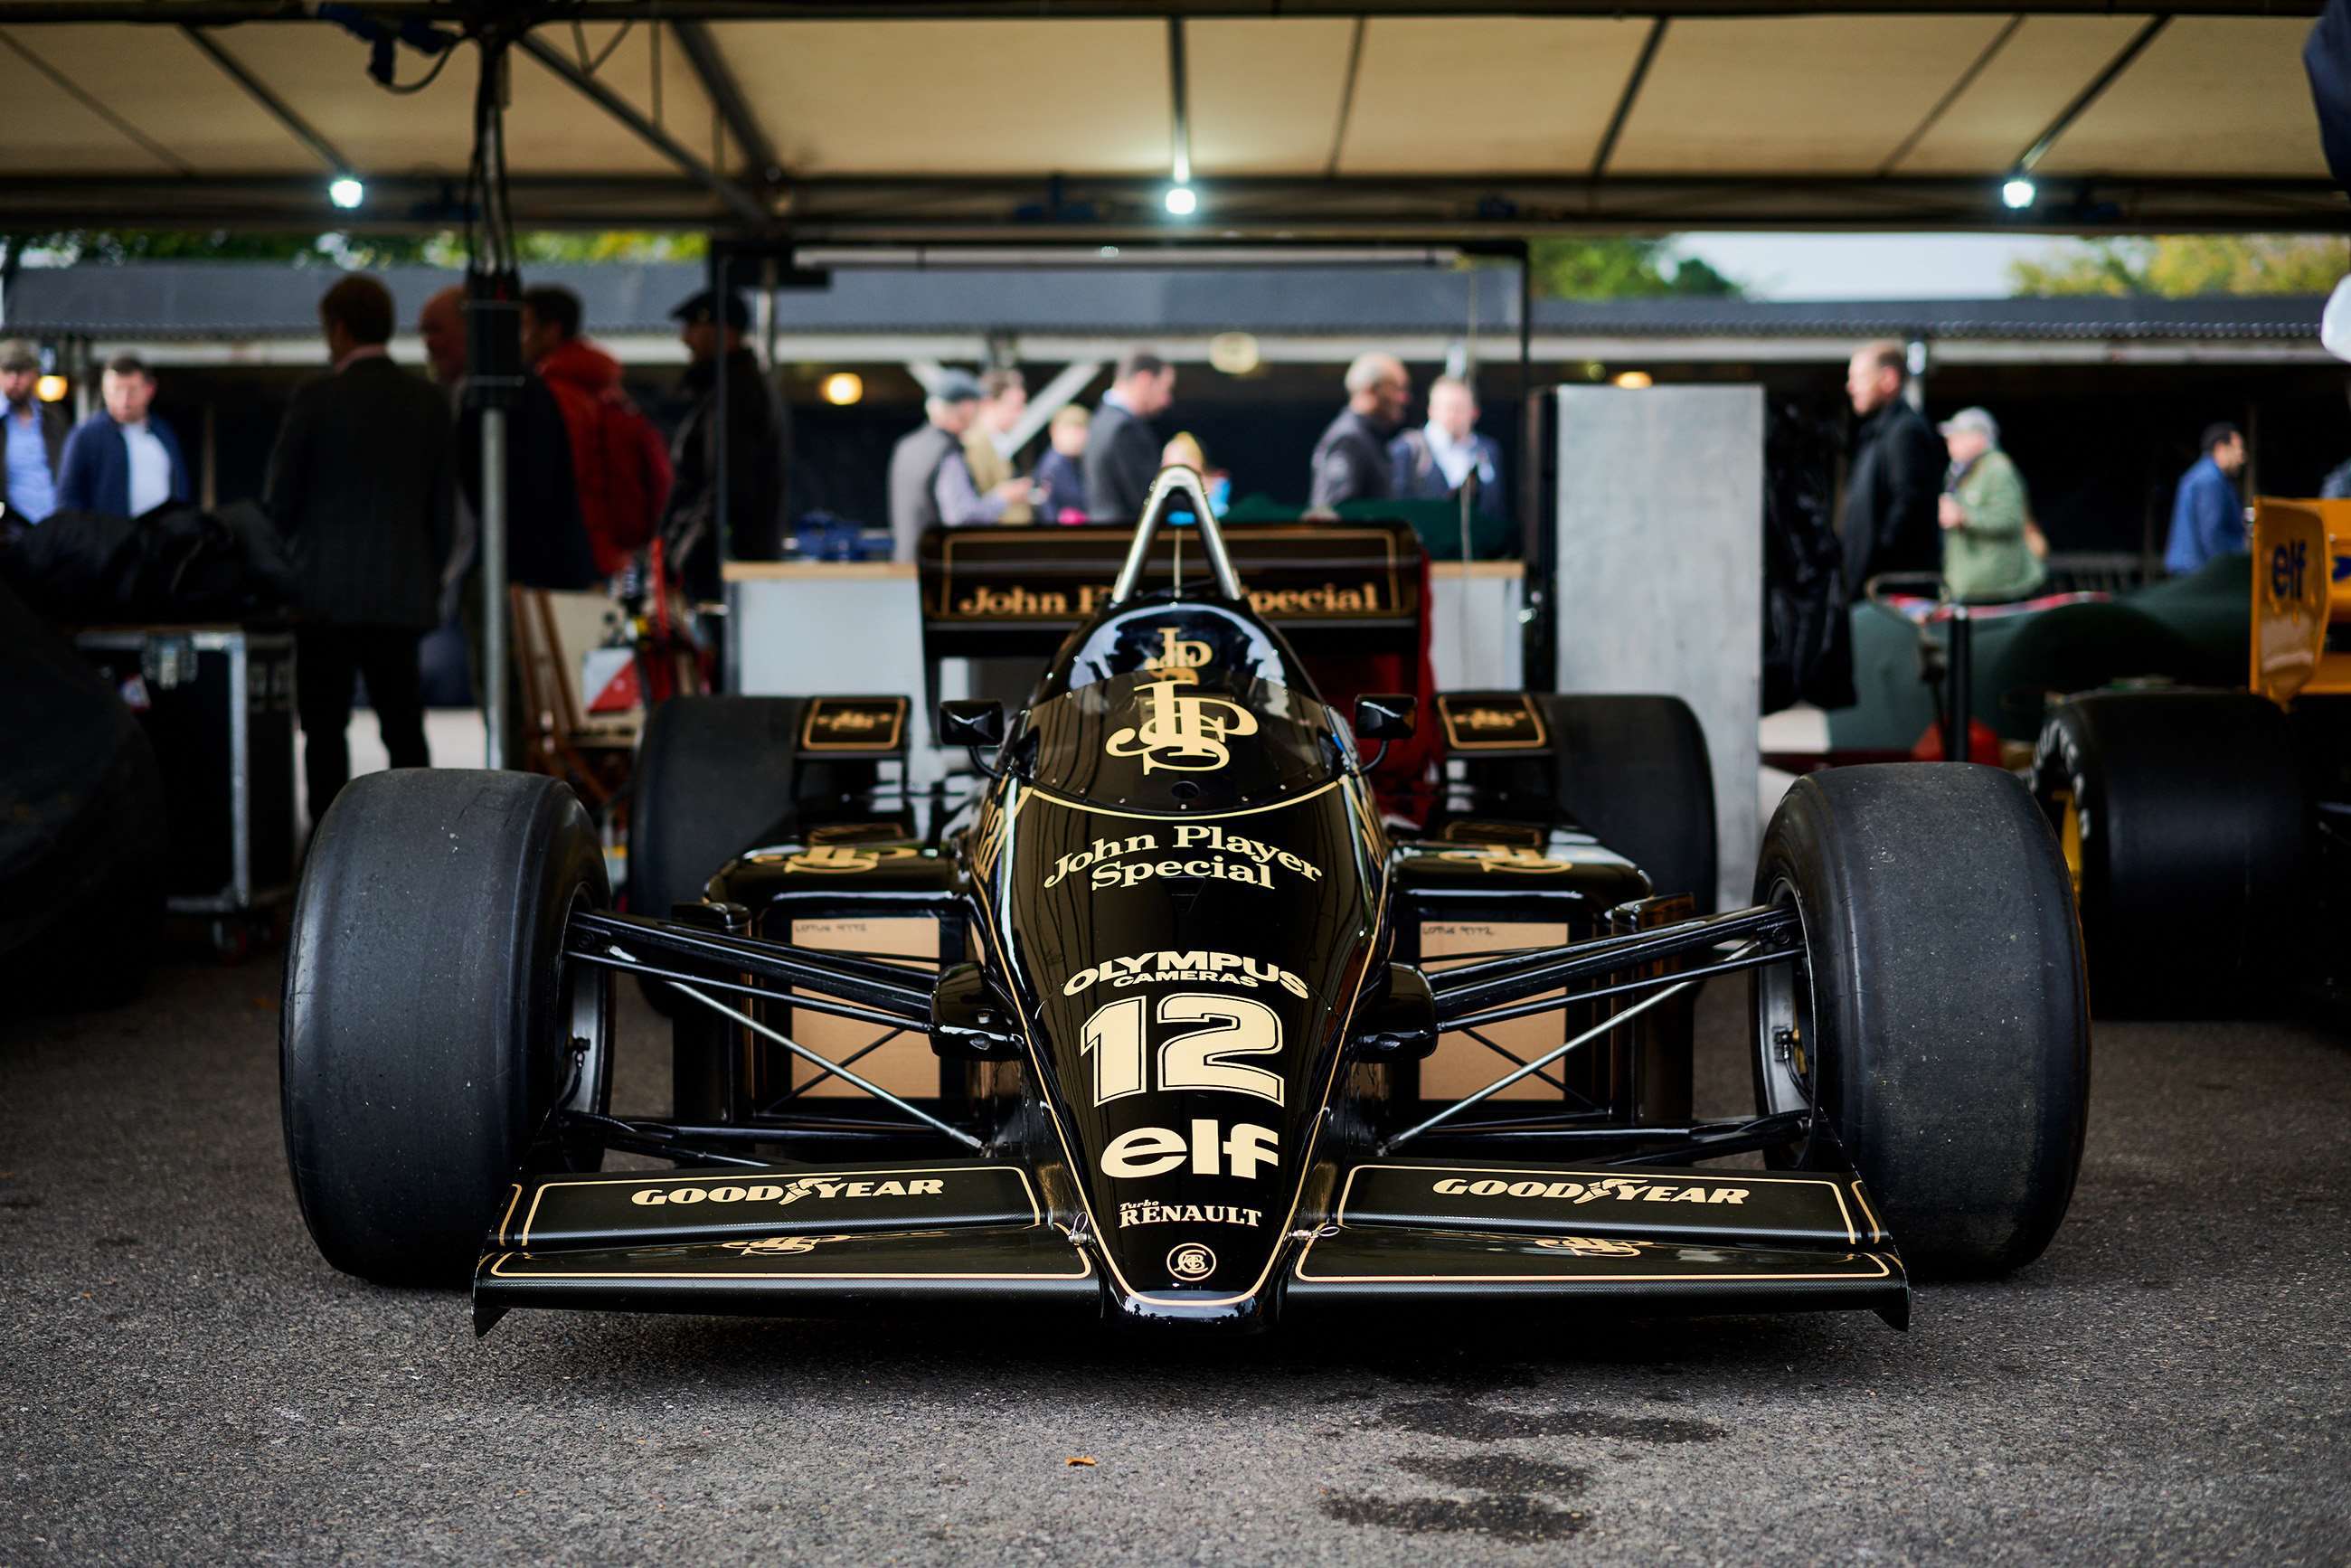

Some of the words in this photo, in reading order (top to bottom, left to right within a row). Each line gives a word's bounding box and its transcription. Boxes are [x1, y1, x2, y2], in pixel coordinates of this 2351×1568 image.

[2273, 539, 2307, 600] elf
[958, 585, 1067, 616] John
[1242, 582, 1378, 613] pecial
[1043, 834, 1160, 890] John
[1172, 825, 1324, 883] Player
[1091, 855, 1277, 892] Special
[1062, 950, 1310, 1000] OLYMPUS
[1112, 970, 1259, 988] CAMERAS
[1080, 992, 1285, 1108] 12
[1100, 1119, 1279, 1180] elf
[1119, 1199, 1160, 1212] Turbo
[1119, 1204, 1262, 1229] RENAULT
